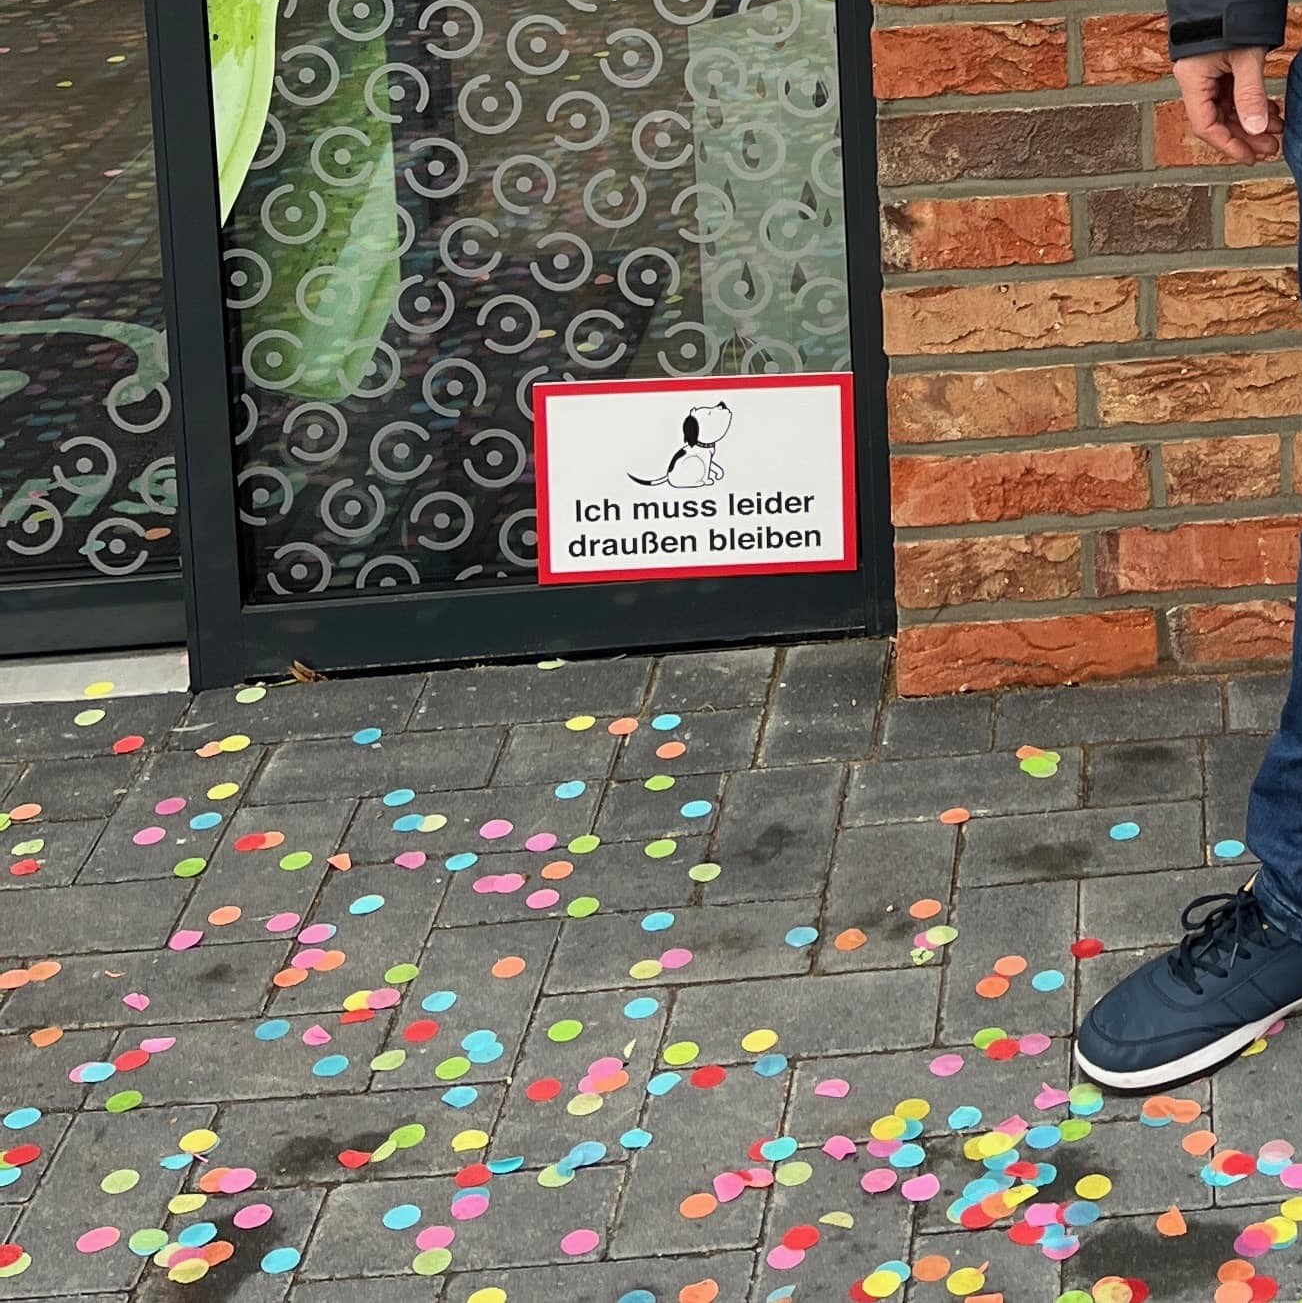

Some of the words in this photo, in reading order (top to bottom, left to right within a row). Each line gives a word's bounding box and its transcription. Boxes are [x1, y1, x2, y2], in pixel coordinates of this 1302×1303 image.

[575, 498, 621, 523] Ich
[633, 499, 717, 520] muss
[728, 491, 815, 517] leider
[567, 530, 697, 558] draußen
[709, 526, 822, 552] bleiben
